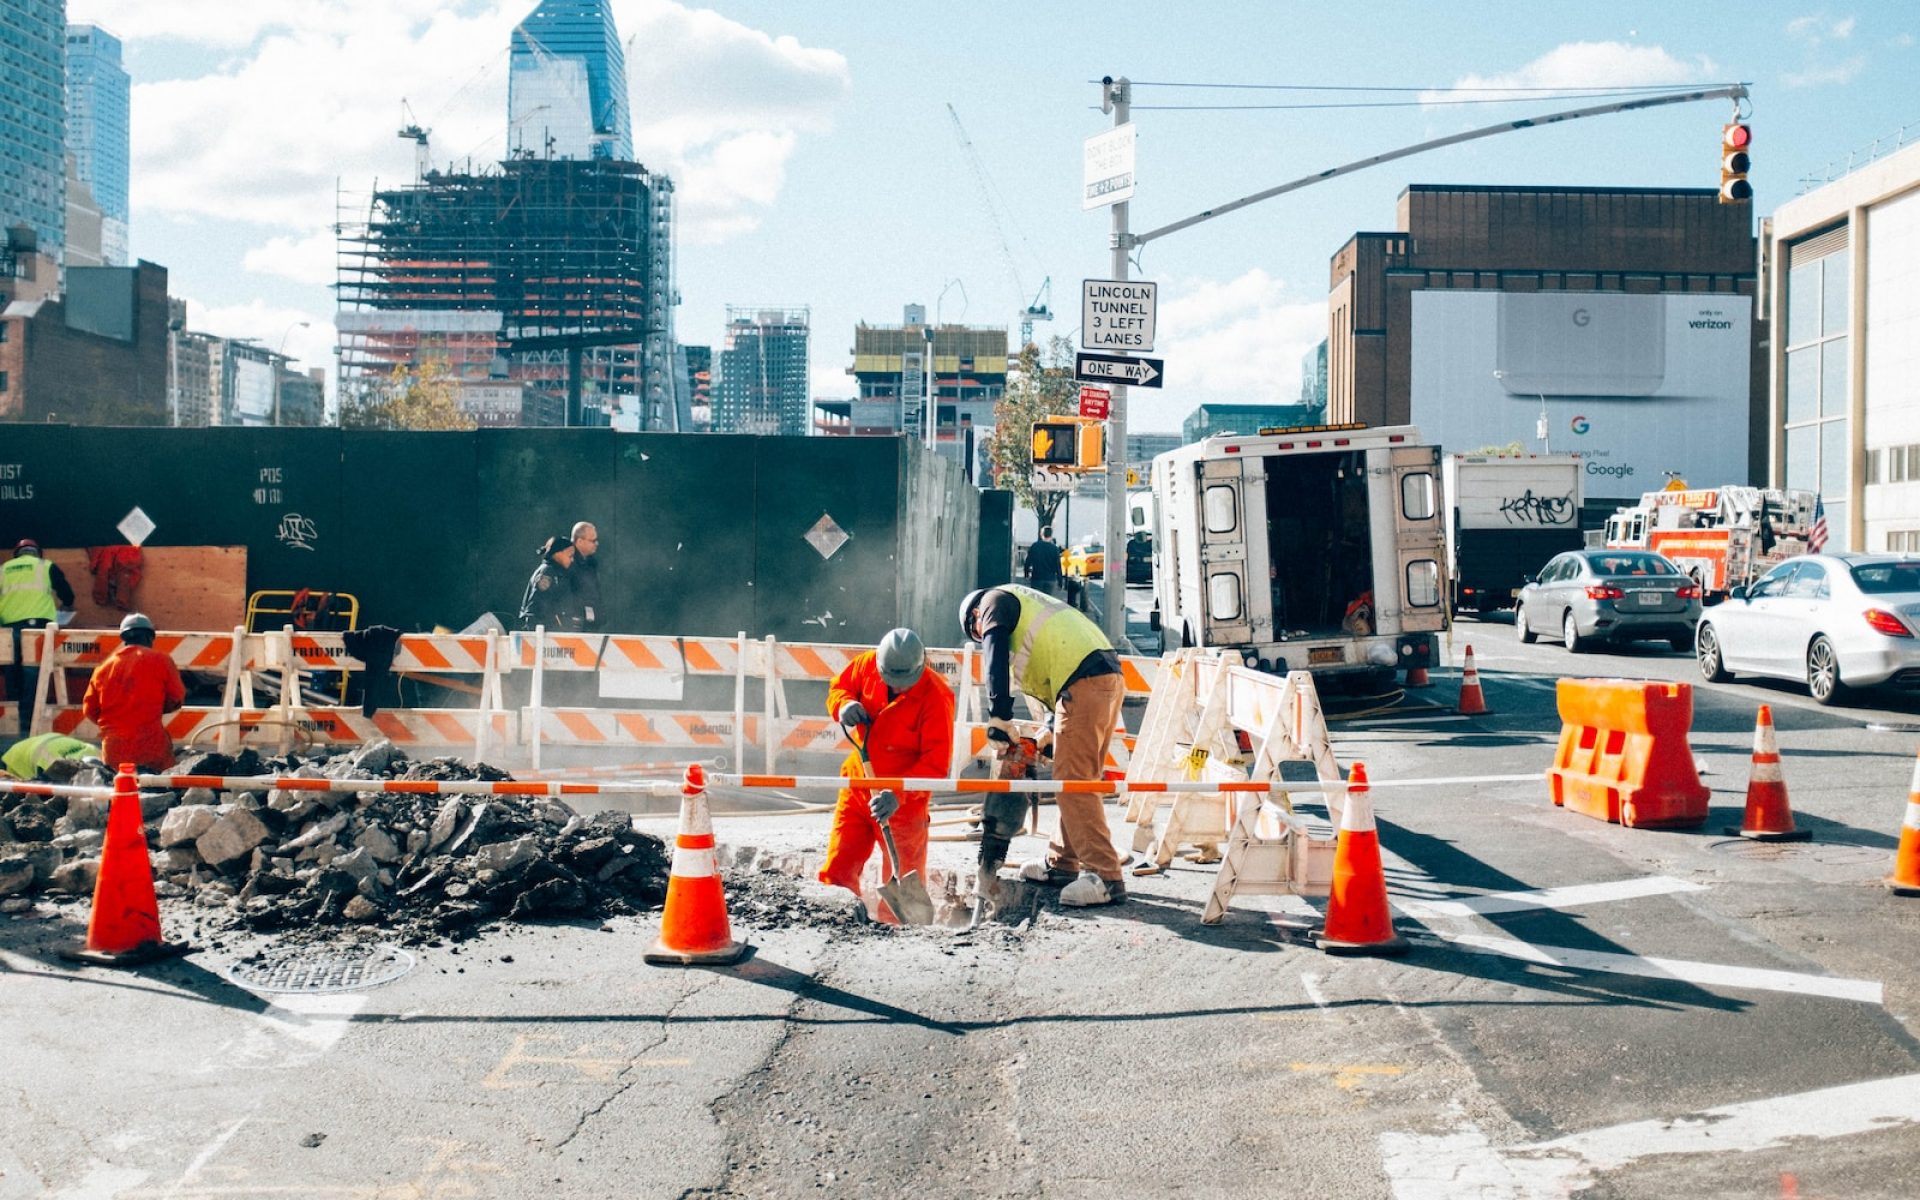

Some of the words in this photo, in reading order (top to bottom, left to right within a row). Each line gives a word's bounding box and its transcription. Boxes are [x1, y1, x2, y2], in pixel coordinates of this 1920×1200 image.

[1090, 286, 1150, 300] LINCOLN
[1091, 301, 1147, 315] TUNNEL
[1093, 316, 1101, 328] 3
[1110, 317, 1145, 330] LEFT
[1573, 308, 1590, 327] G
[1688, 319, 1731, 329] verizon
[1095, 331, 1143, 345] LANES
[1088, 362, 1113, 375] ONE
[1125, 365, 1151, 378] WAY
[1571, 416, 1590, 435] G
[0, 464, 22, 479] OST
[1586, 461, 1634, 479] Google
[62, 641, 101, 654] TRIUMPH
